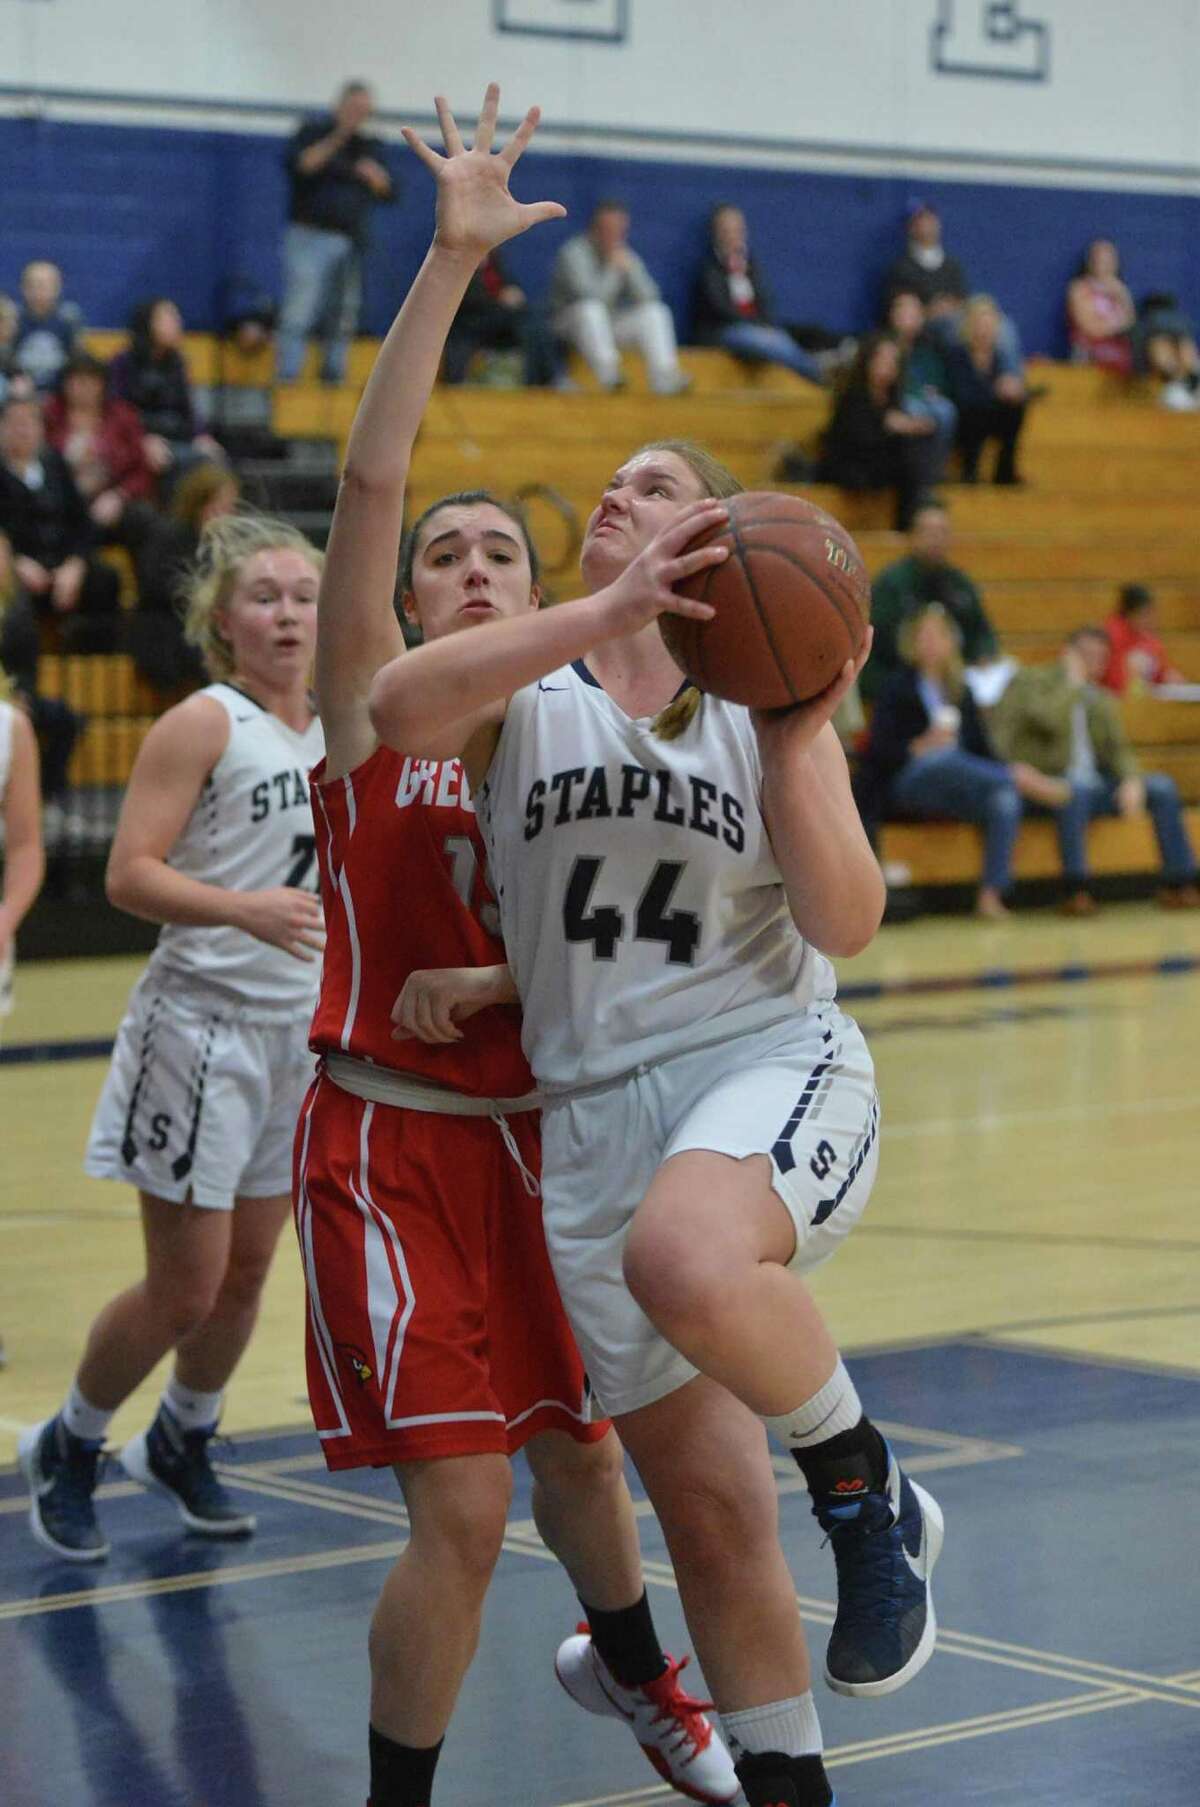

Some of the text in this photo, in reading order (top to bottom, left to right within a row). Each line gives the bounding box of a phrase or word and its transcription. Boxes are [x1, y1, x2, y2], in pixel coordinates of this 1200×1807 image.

[251, 768, 312, 822] STA
[524, 764, 744, 852] STAPLES
[562, 854, 703, 967] 44
[148, 1113, 171, 1150] S
[809, 1139, 837, 1180] S
